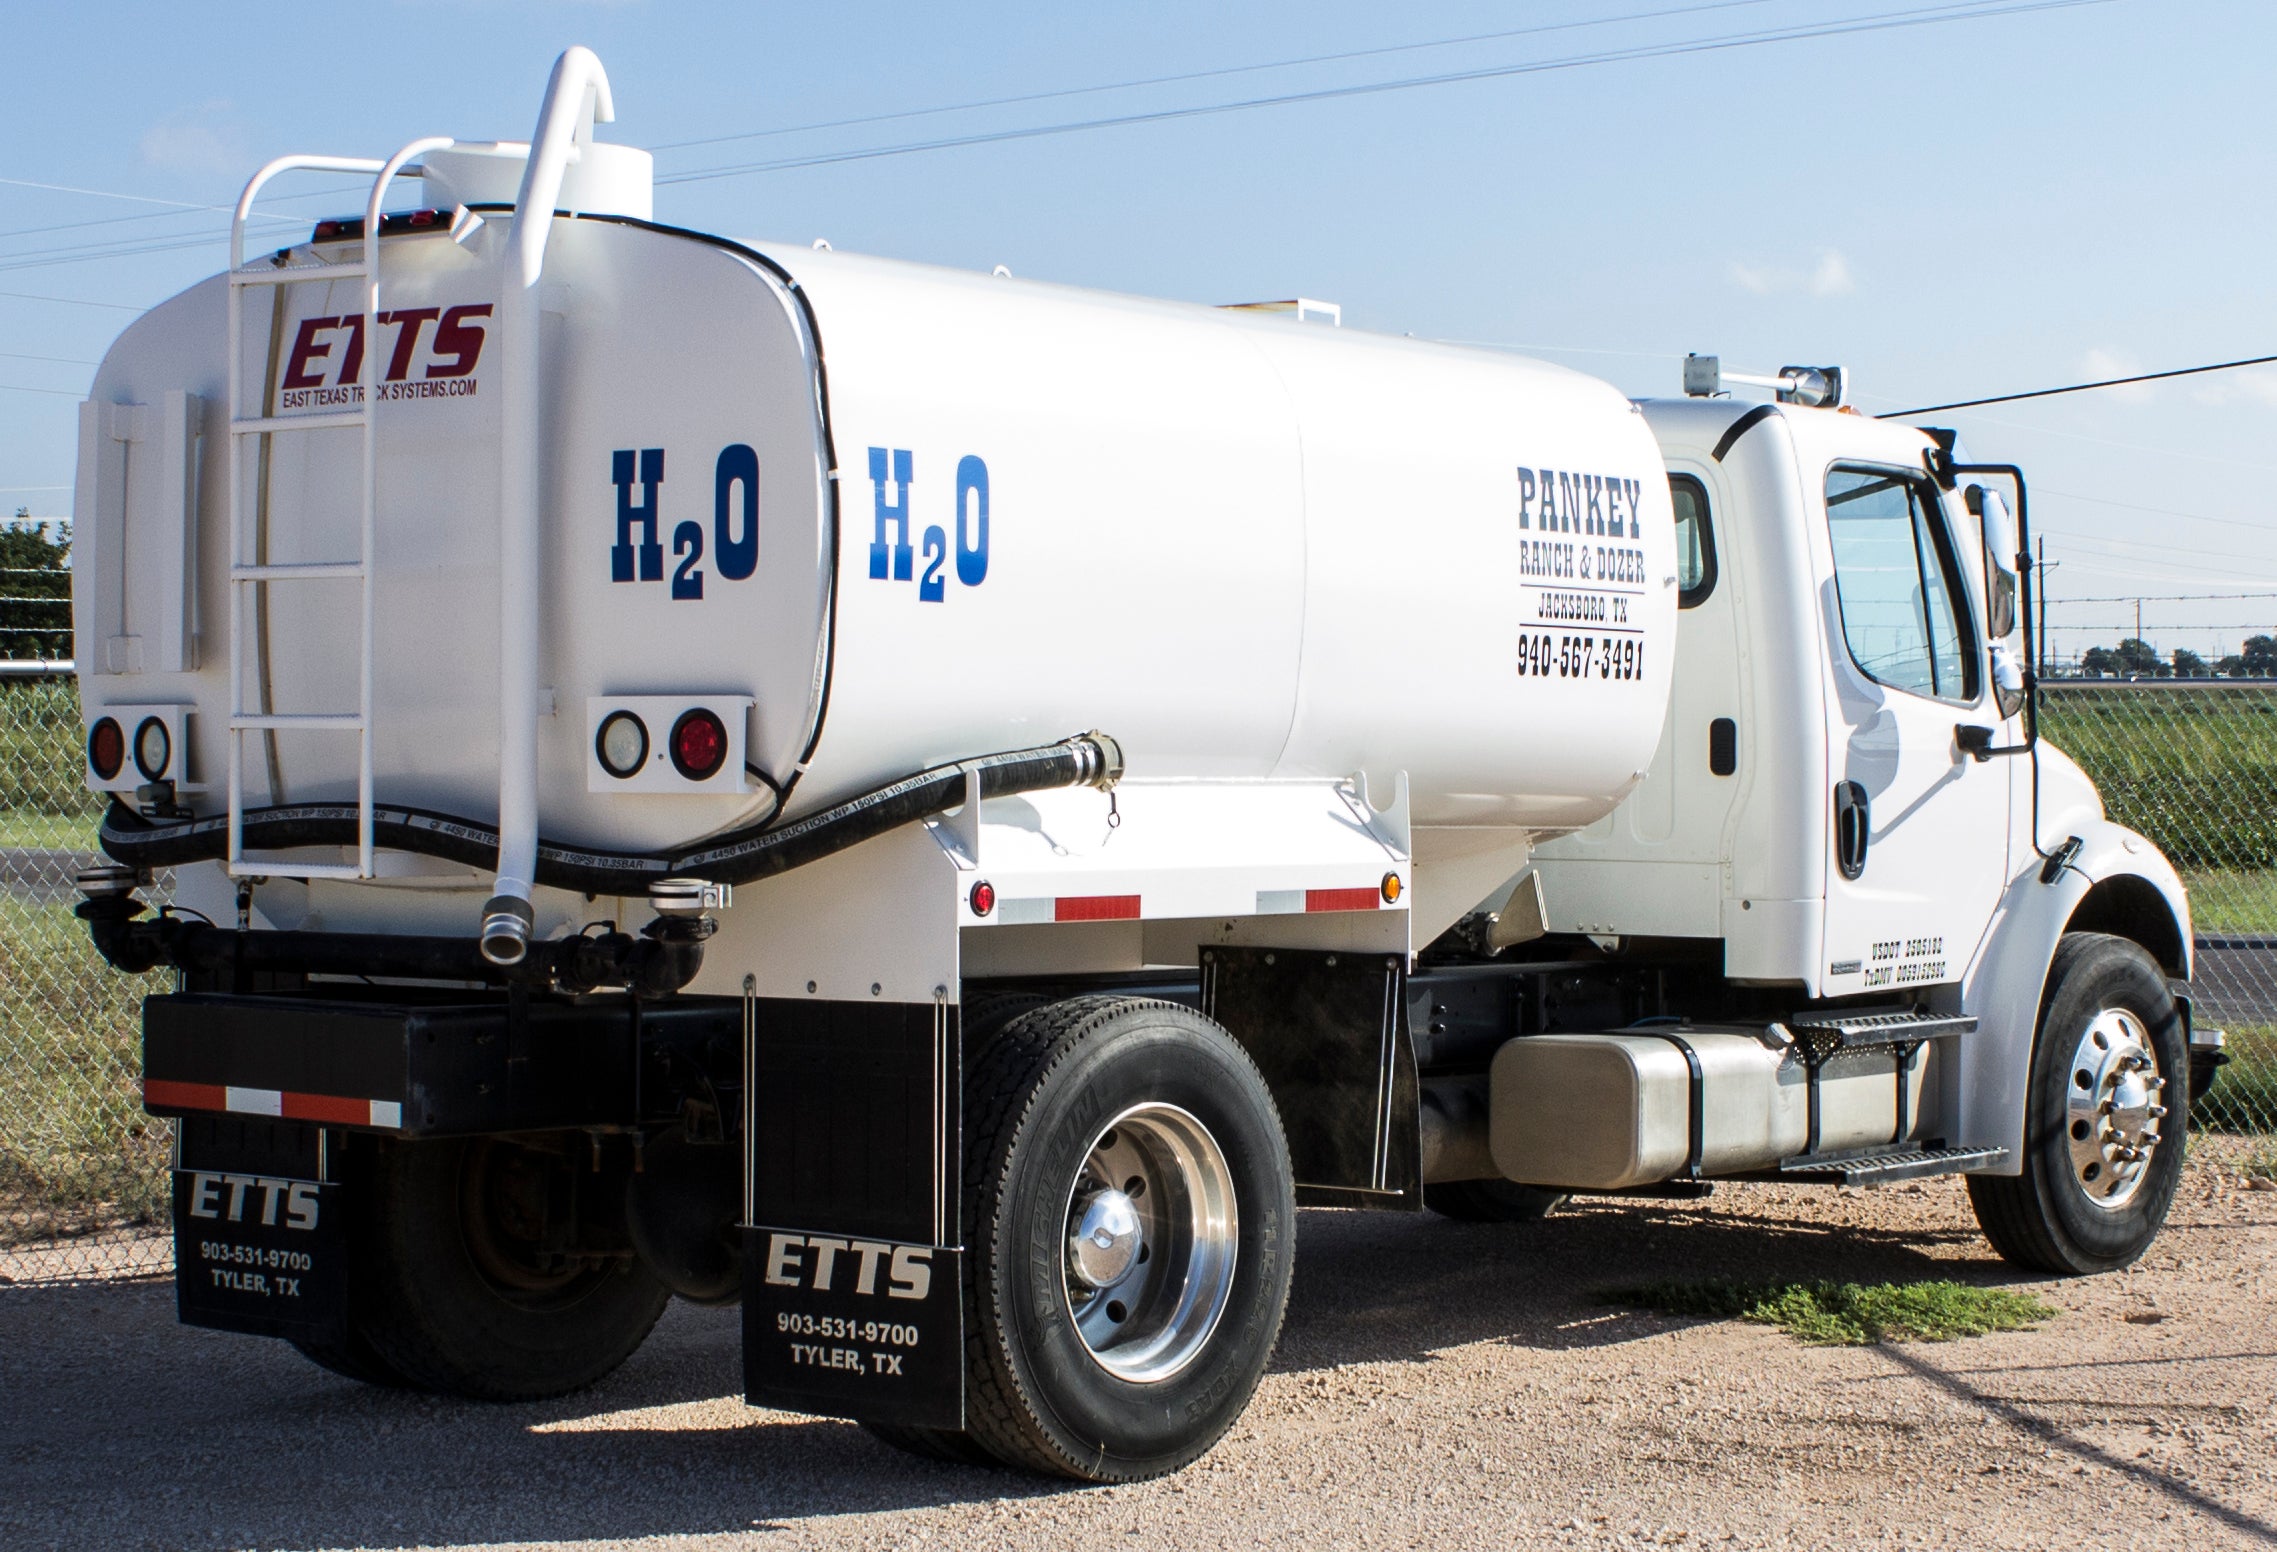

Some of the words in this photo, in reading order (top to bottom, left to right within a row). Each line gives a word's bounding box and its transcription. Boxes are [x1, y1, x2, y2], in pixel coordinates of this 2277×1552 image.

[281, 303, 494, 389] ETTS
[283, 391, 311, 408] EAST
[313, 388, 348, 405] TEXAS
[392, 379, 477, 400] SYSTEMS.COM
[612, 443, 760, 600] H2O
[868, 446, 989, 603] H2O
[1517, 467, 1641, 539] PANKEY
[1520, 540, 1574, 578] RANCH
[1580, 545, 1592, 580] &
[1597, 546, 1645, 583] DOZER
[1538, 593, 1608, 623] JACKSBORO,
[1612, 597, 1628, 623] TX
[1518, 634, 1643, 680] 940-567-3491
[711, 847, 737, 860] 4450
[737, 834, 779, 853] WATER
[780, 814, 830, 839] SUCTION
[831, 806, 850, 820] WP
[852, 791, 888, 811] 150PSI
[190, 1173, 320, 1230] ETTS
[1032, 1083, 1100, 1307] MICHELIN
[201, 1241, 312, 1271] 903-531-9700
[765, 1233, 933, 1300] ETTS
[211, 1268, 271, 1297] TYLER,
[275, 1277, 300, 1297] TX
[777, 1312, 919, 1346] 903-531-9700
[791, 1343, 866, 1376] TYLER,
[872, 1352, 903, 1376] TX
